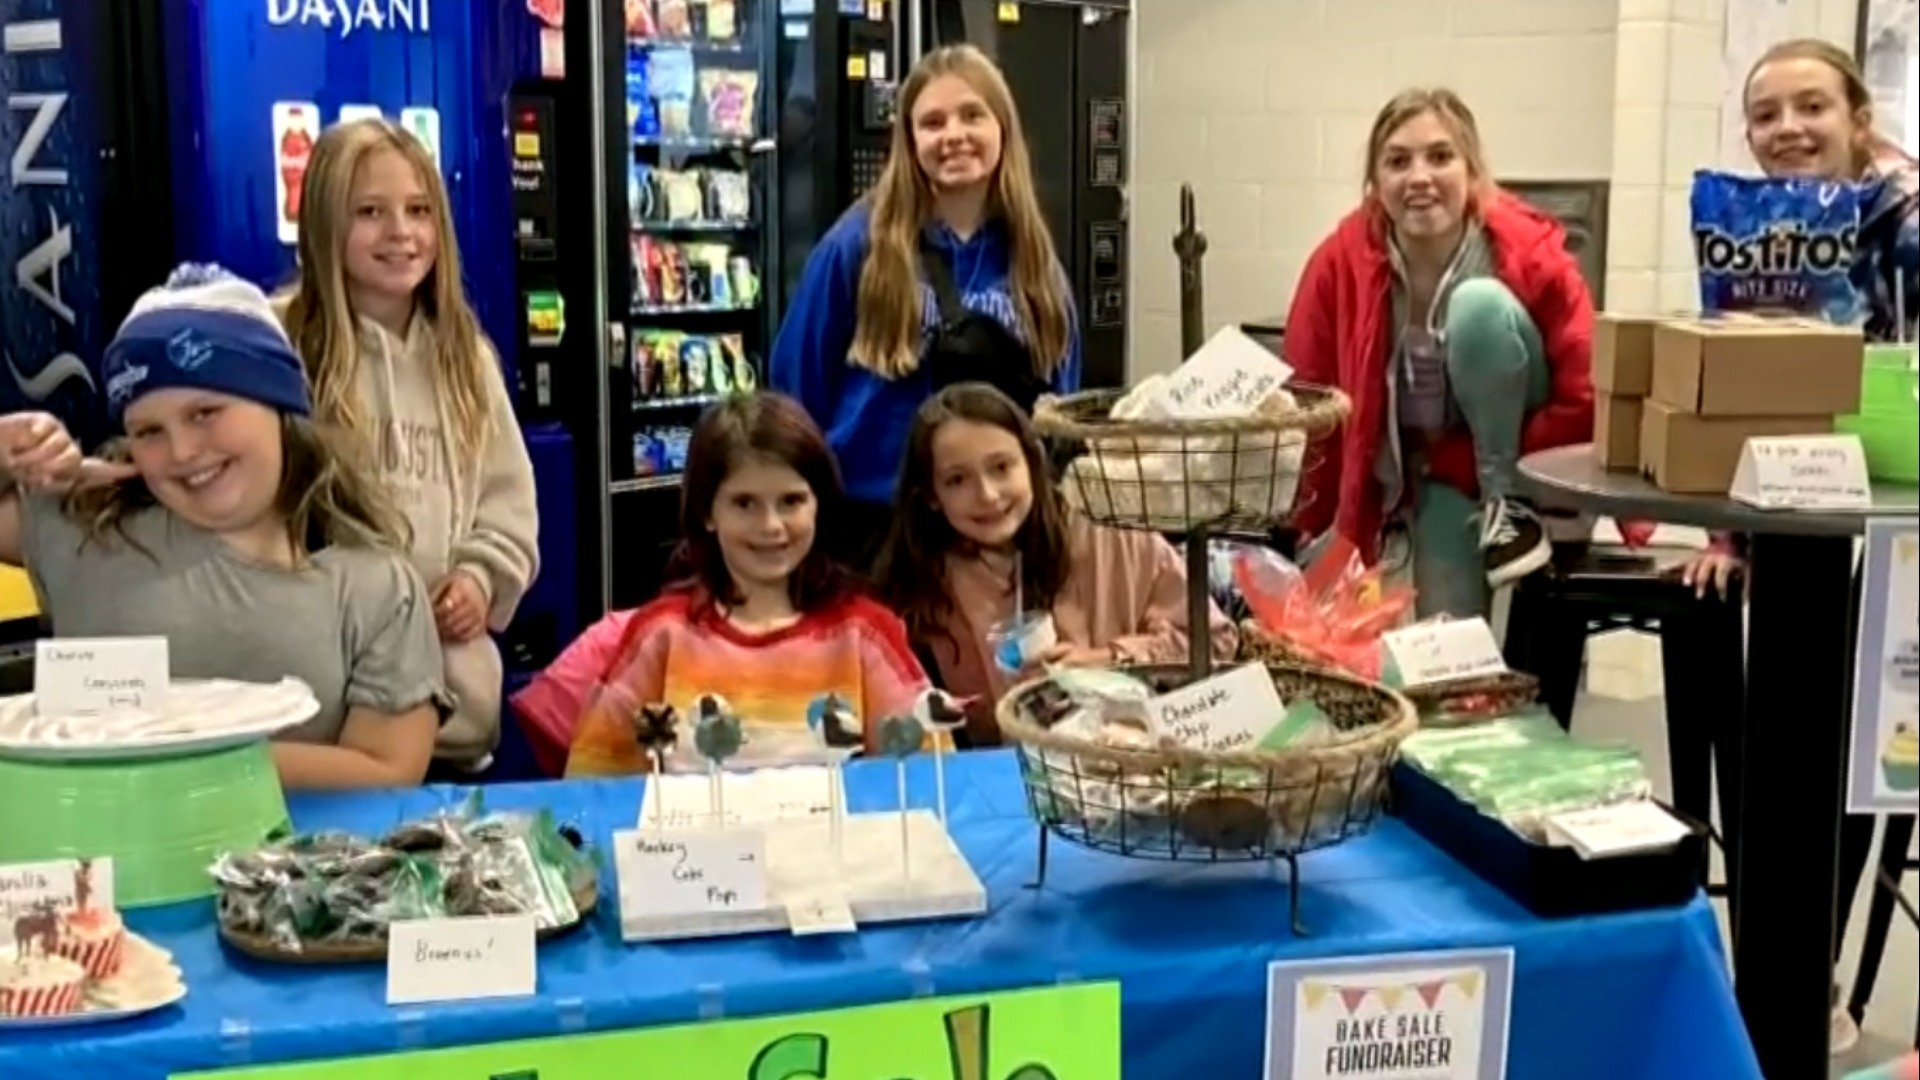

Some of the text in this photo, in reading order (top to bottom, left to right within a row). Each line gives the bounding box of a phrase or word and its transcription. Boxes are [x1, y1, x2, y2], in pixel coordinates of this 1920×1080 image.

[267, 0, 431, 39] DASANI
[636, 839, 688, 863] Hockey
[1336, 1010, 1445, 1043] BAKE SALE
[1325, 1037, 1452, 1075] FUNDRAISER
